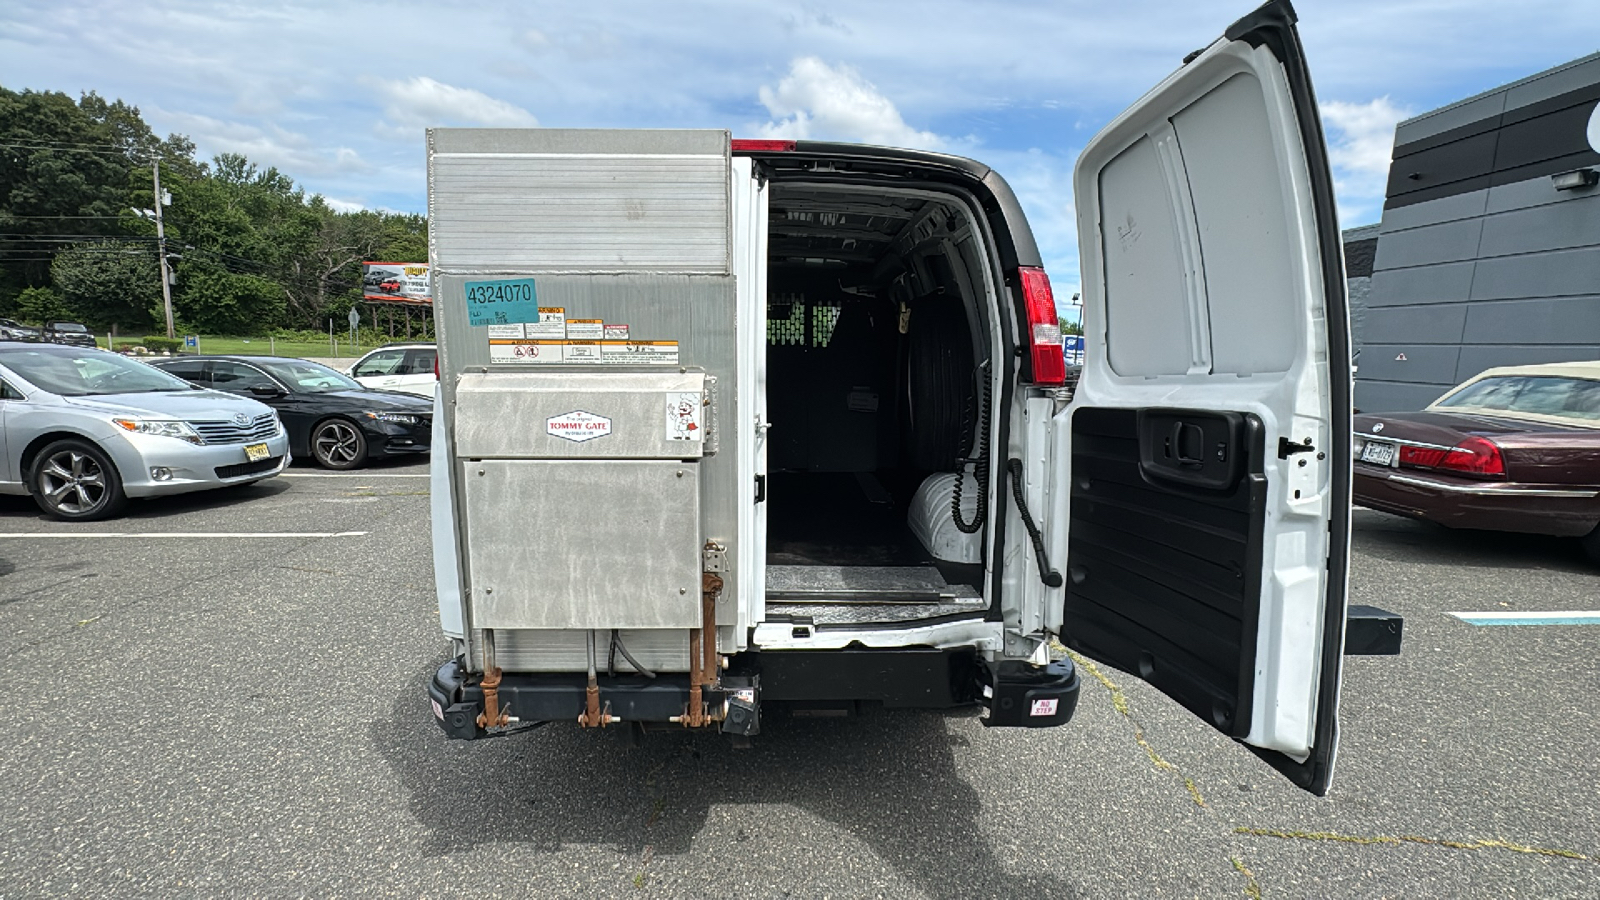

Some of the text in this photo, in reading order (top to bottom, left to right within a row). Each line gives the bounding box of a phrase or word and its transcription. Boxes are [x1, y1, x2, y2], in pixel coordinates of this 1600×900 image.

[468, 284, 531, 304] 4324070
[550, 422, 607, 430] TOMMY GATE
